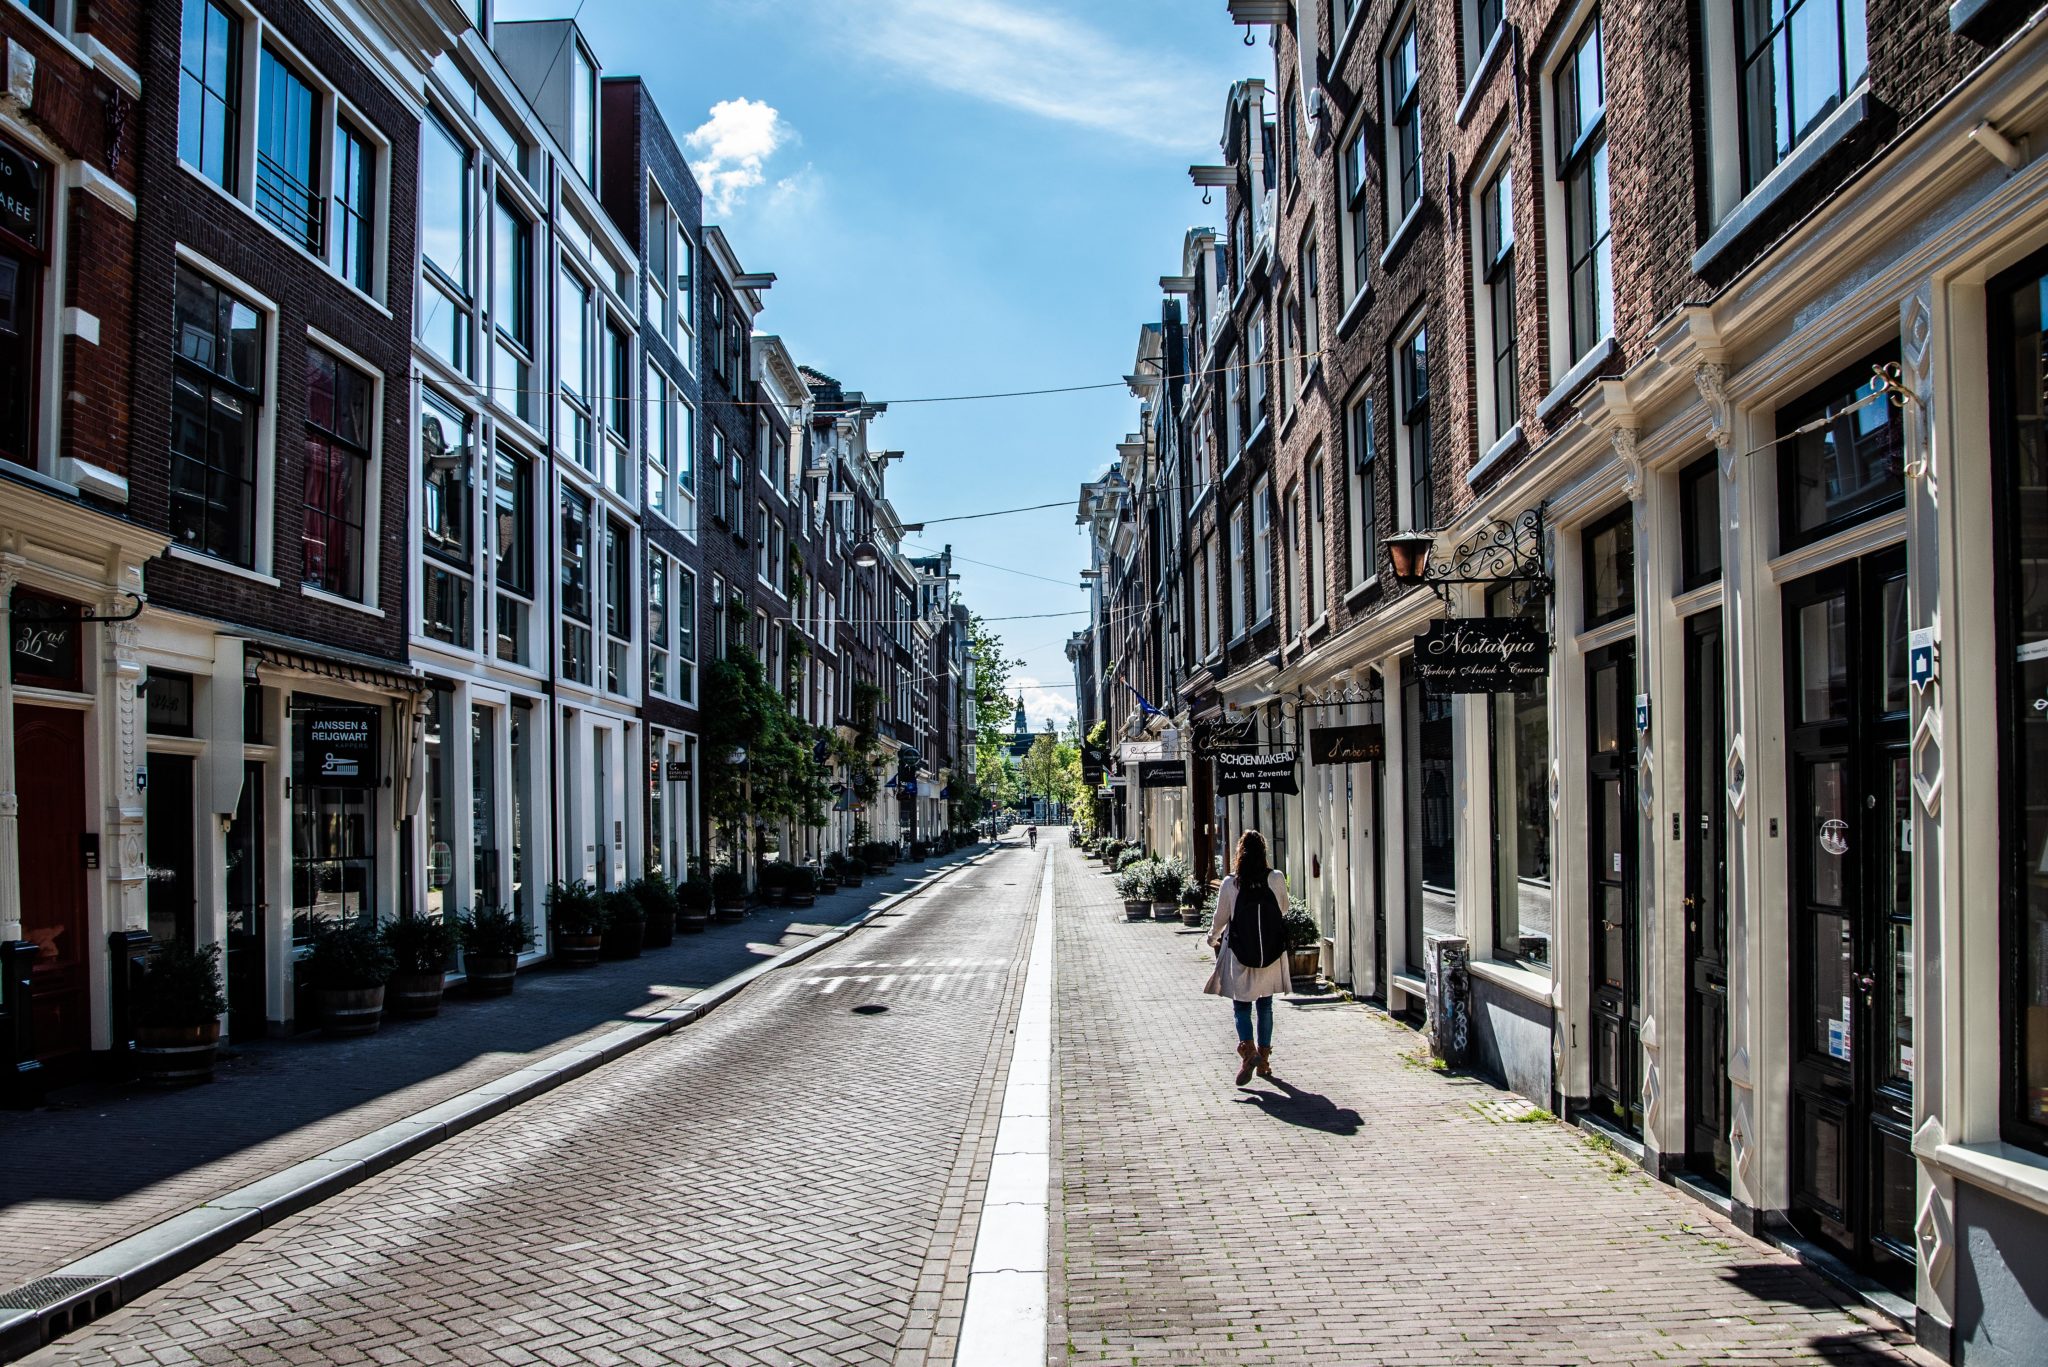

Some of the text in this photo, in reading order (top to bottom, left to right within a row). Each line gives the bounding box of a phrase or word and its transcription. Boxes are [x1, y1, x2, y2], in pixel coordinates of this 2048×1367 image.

[1428, 630, 1535, 662] Nostalgia
[1420, 664, 1456, 678] Verkoop
[1460, 664, 1497, 675] Antiek
[1509, 662, 1544, 675] Curiosa
[312, 721, 368, 730] JANSSEN &
[311, 732, 368, 741] REIJGWART
[1219, 751, 1295, 766] SCHOENMAKERIJ
[1224, 771, 1238, 779] A.J.
[1258, 769, 1291, 777] Zeventer
